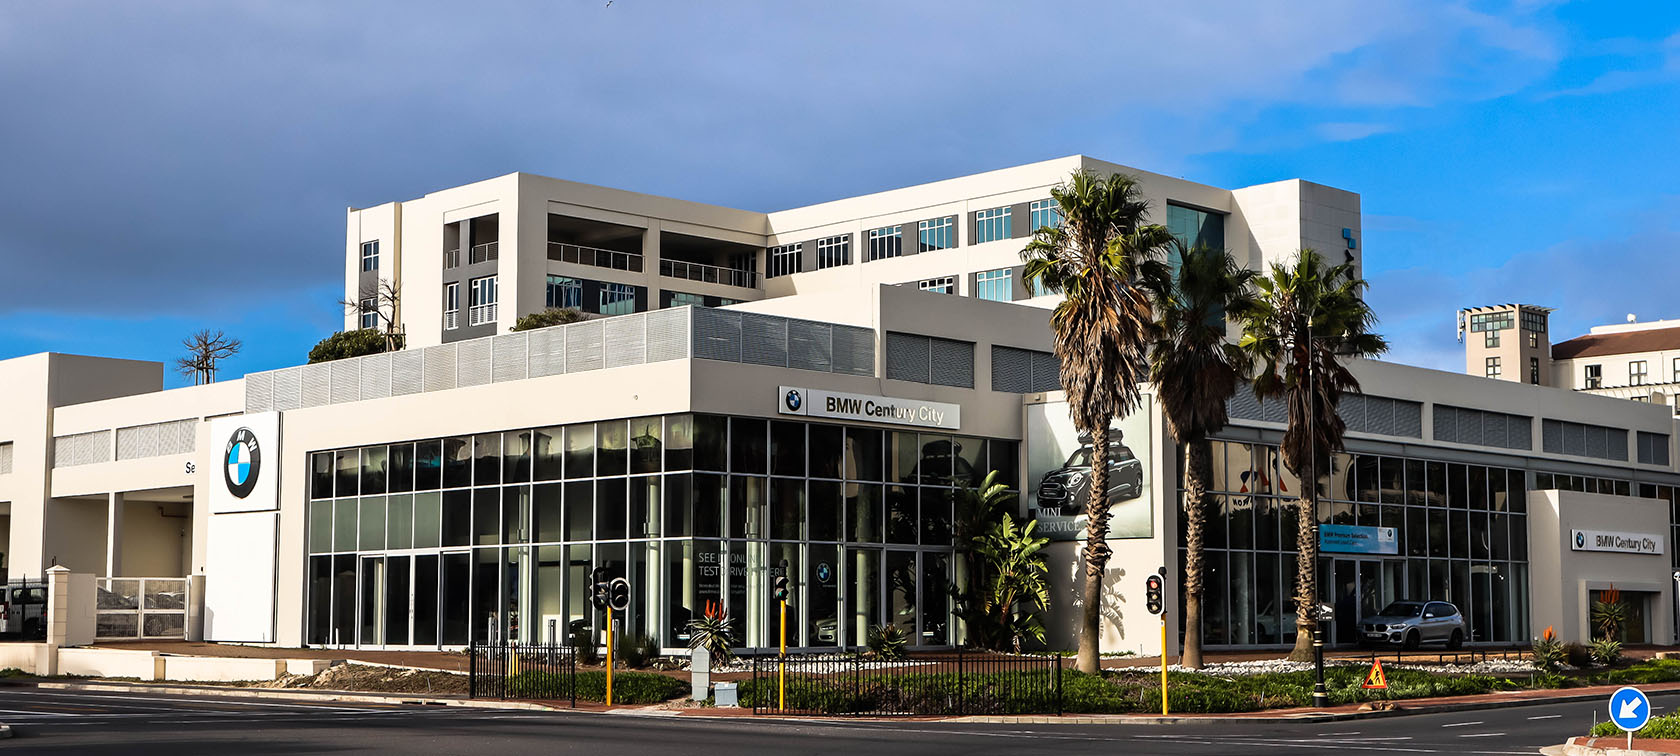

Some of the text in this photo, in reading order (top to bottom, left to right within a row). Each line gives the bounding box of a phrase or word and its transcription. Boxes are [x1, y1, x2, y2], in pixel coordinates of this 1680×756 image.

[826, 396, 945, 426] BMW Century City
[185, 461, 196, 474] Se
[1036, 507, 1061, 518] MINI
[1596, 535, 1656, 552] BMW Century City
[698, 552, 716, 564] SEE
[698, 565, 720, 577] TEST
